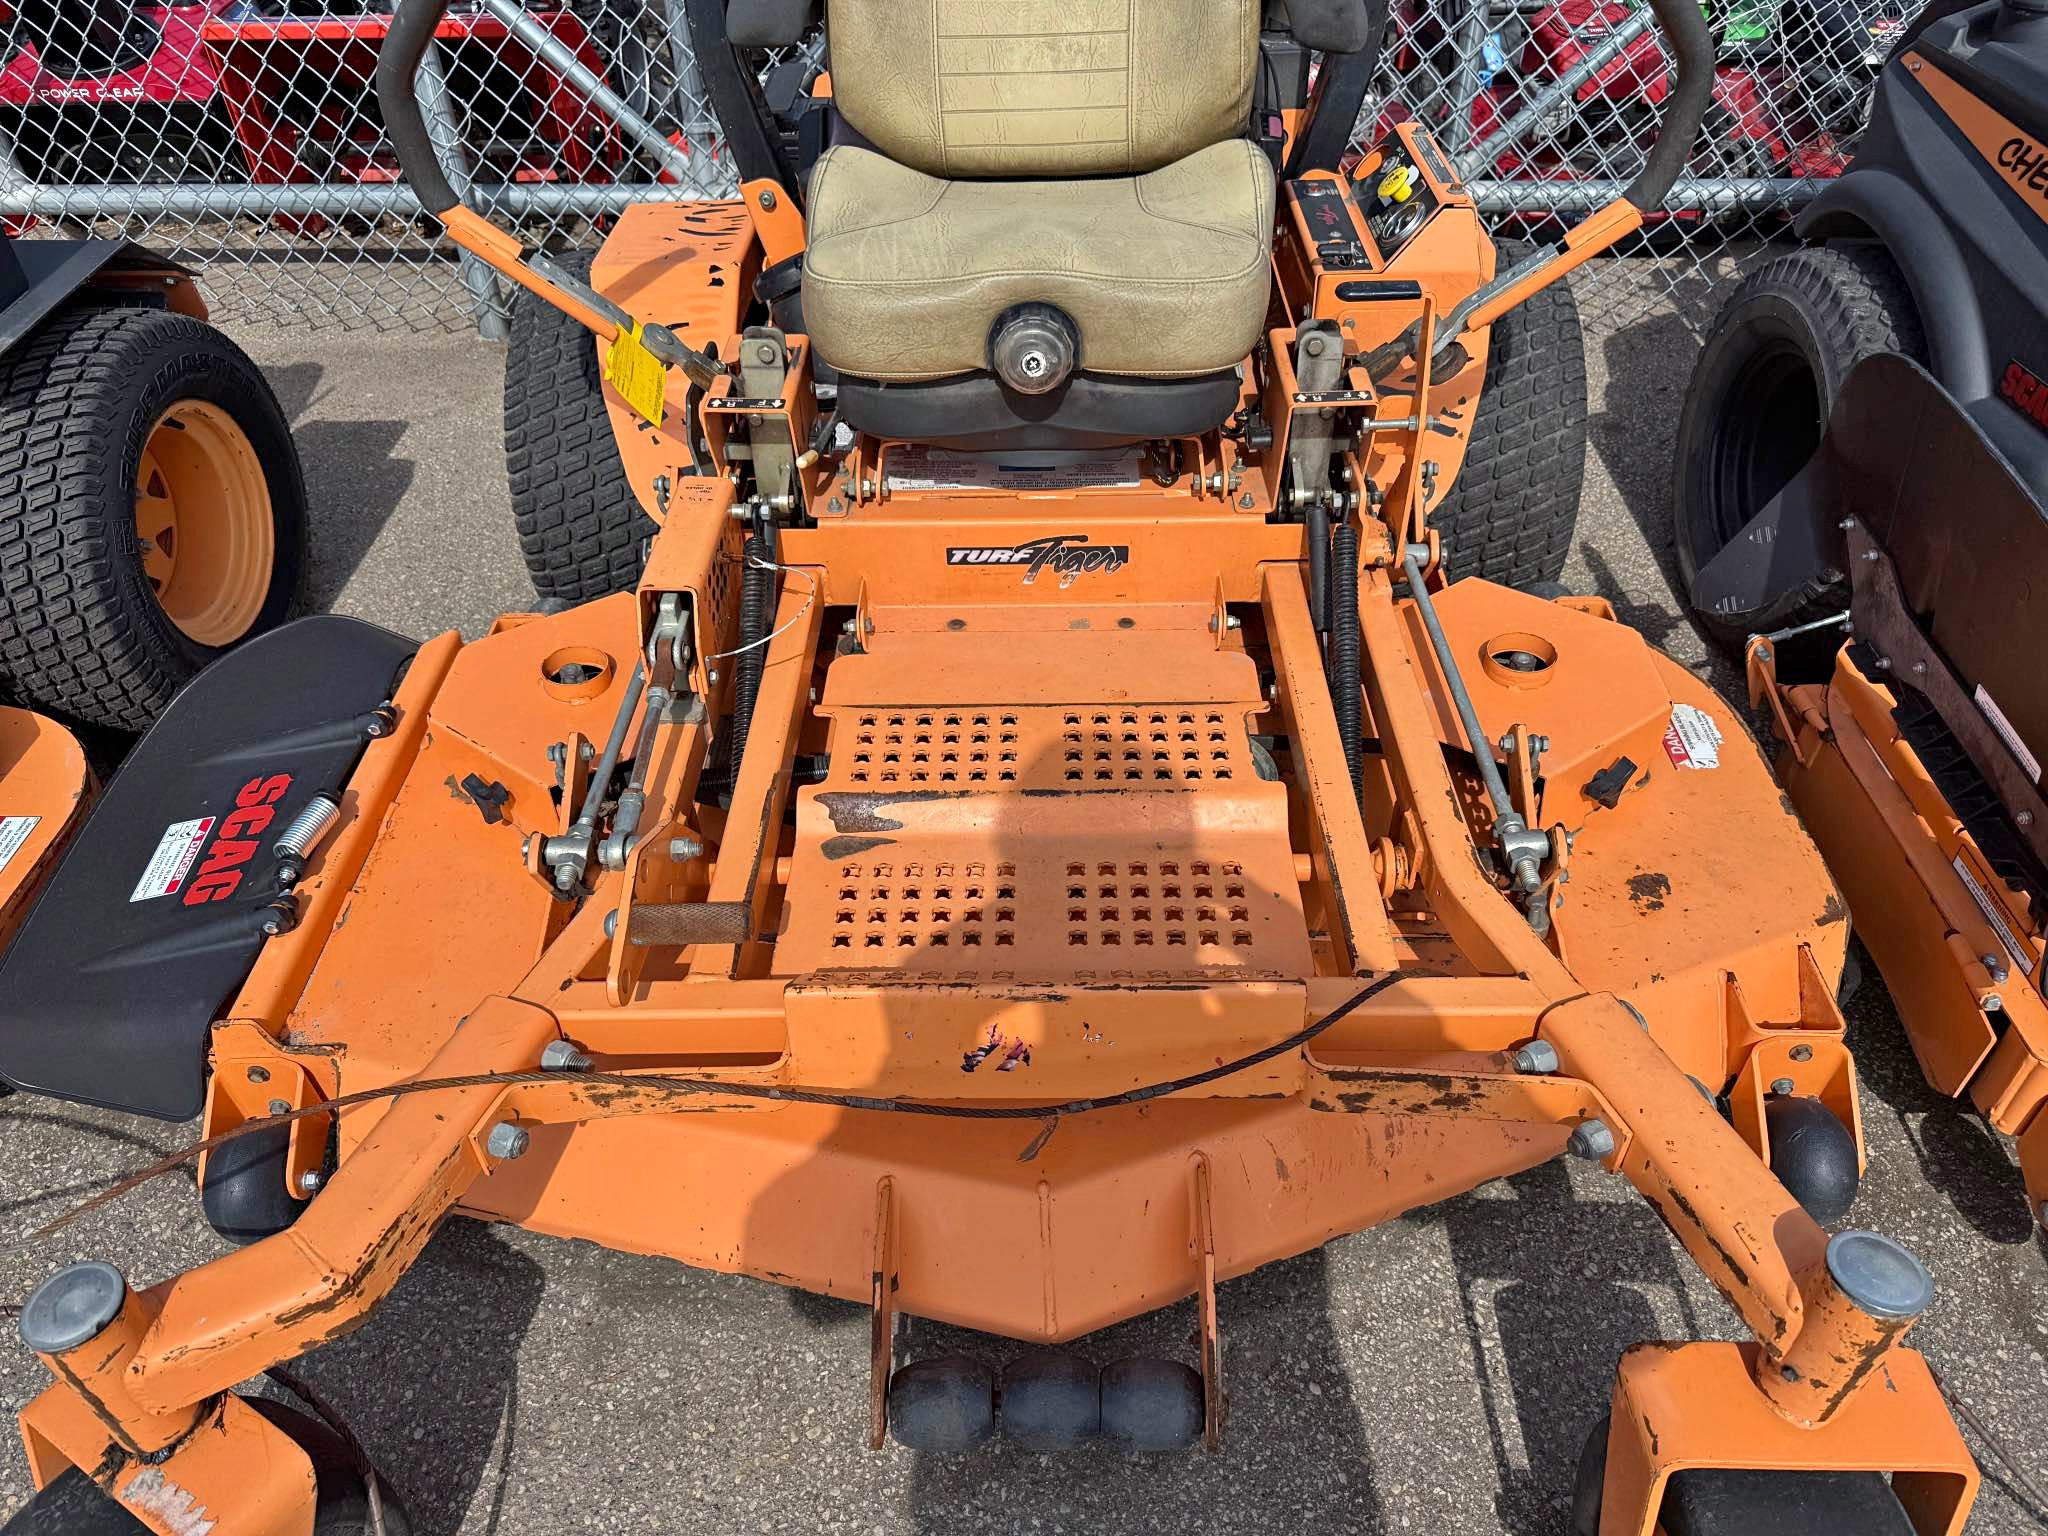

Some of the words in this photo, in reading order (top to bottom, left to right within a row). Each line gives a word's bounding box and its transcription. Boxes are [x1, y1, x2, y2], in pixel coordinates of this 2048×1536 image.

[40, 88, 91, 98] POWER
[96, 87, 145, 98] CLEAR
[120, 384, 153, 489] TURF
[950, 549, 1034, 563] TURF
[1013, 534, 1124, 589] Tiger
[171, 839, 202, 881] DANGER
[183, 774, 294, 906] SCAG
